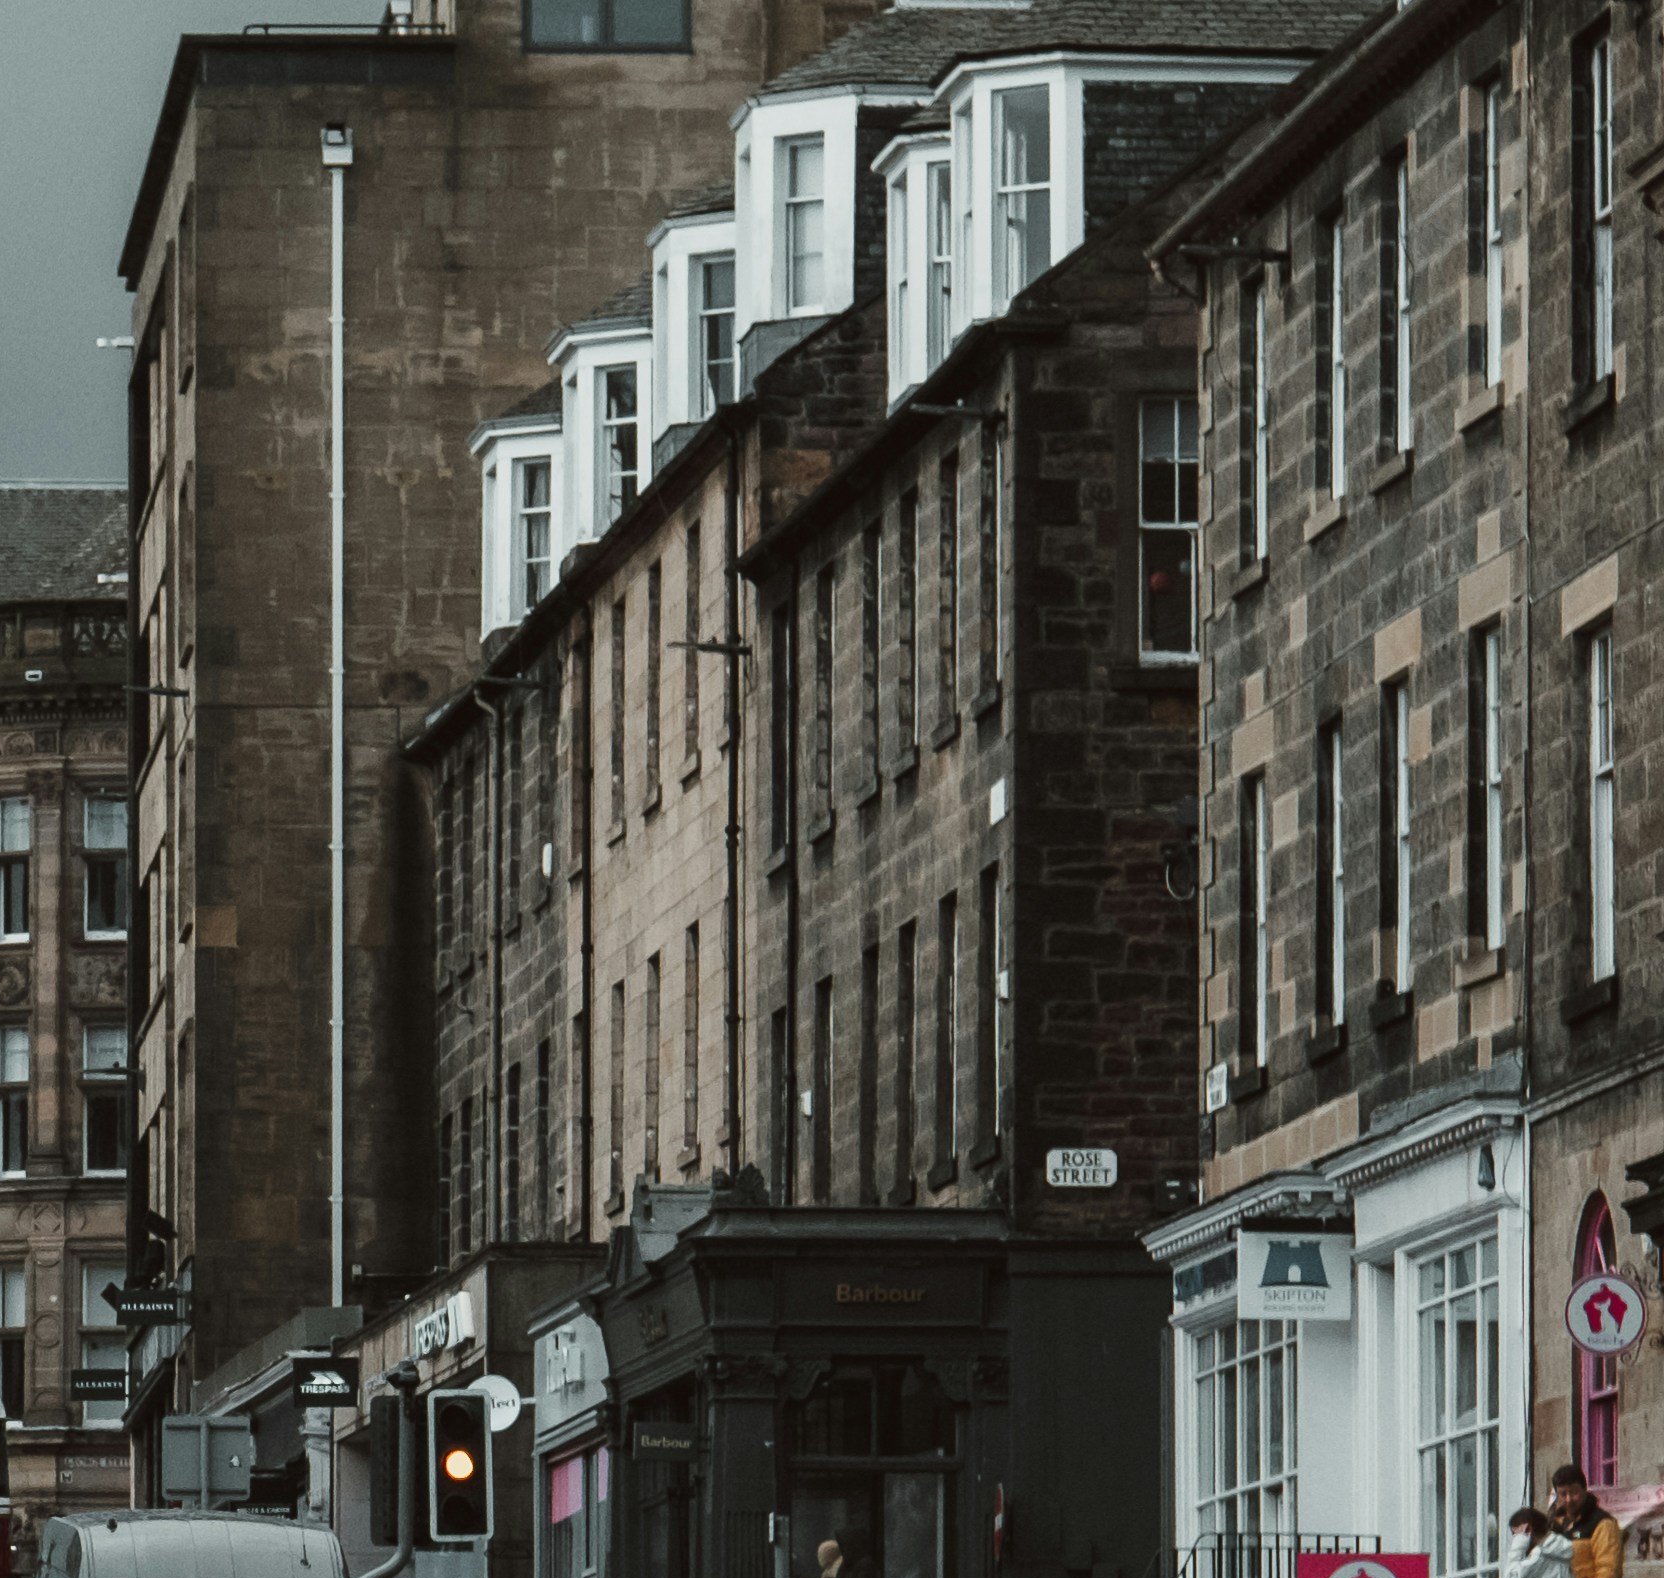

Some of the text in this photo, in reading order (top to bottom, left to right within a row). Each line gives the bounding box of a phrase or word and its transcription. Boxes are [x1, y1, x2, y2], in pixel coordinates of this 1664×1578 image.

[1062, 1152, 1103, 1167] ROSE
[1051, 1169, 1112, 1184] STREET
[835, 1283, 928, 1304] Barbour
[300, 1385, 350, 1394] TRESPASS
